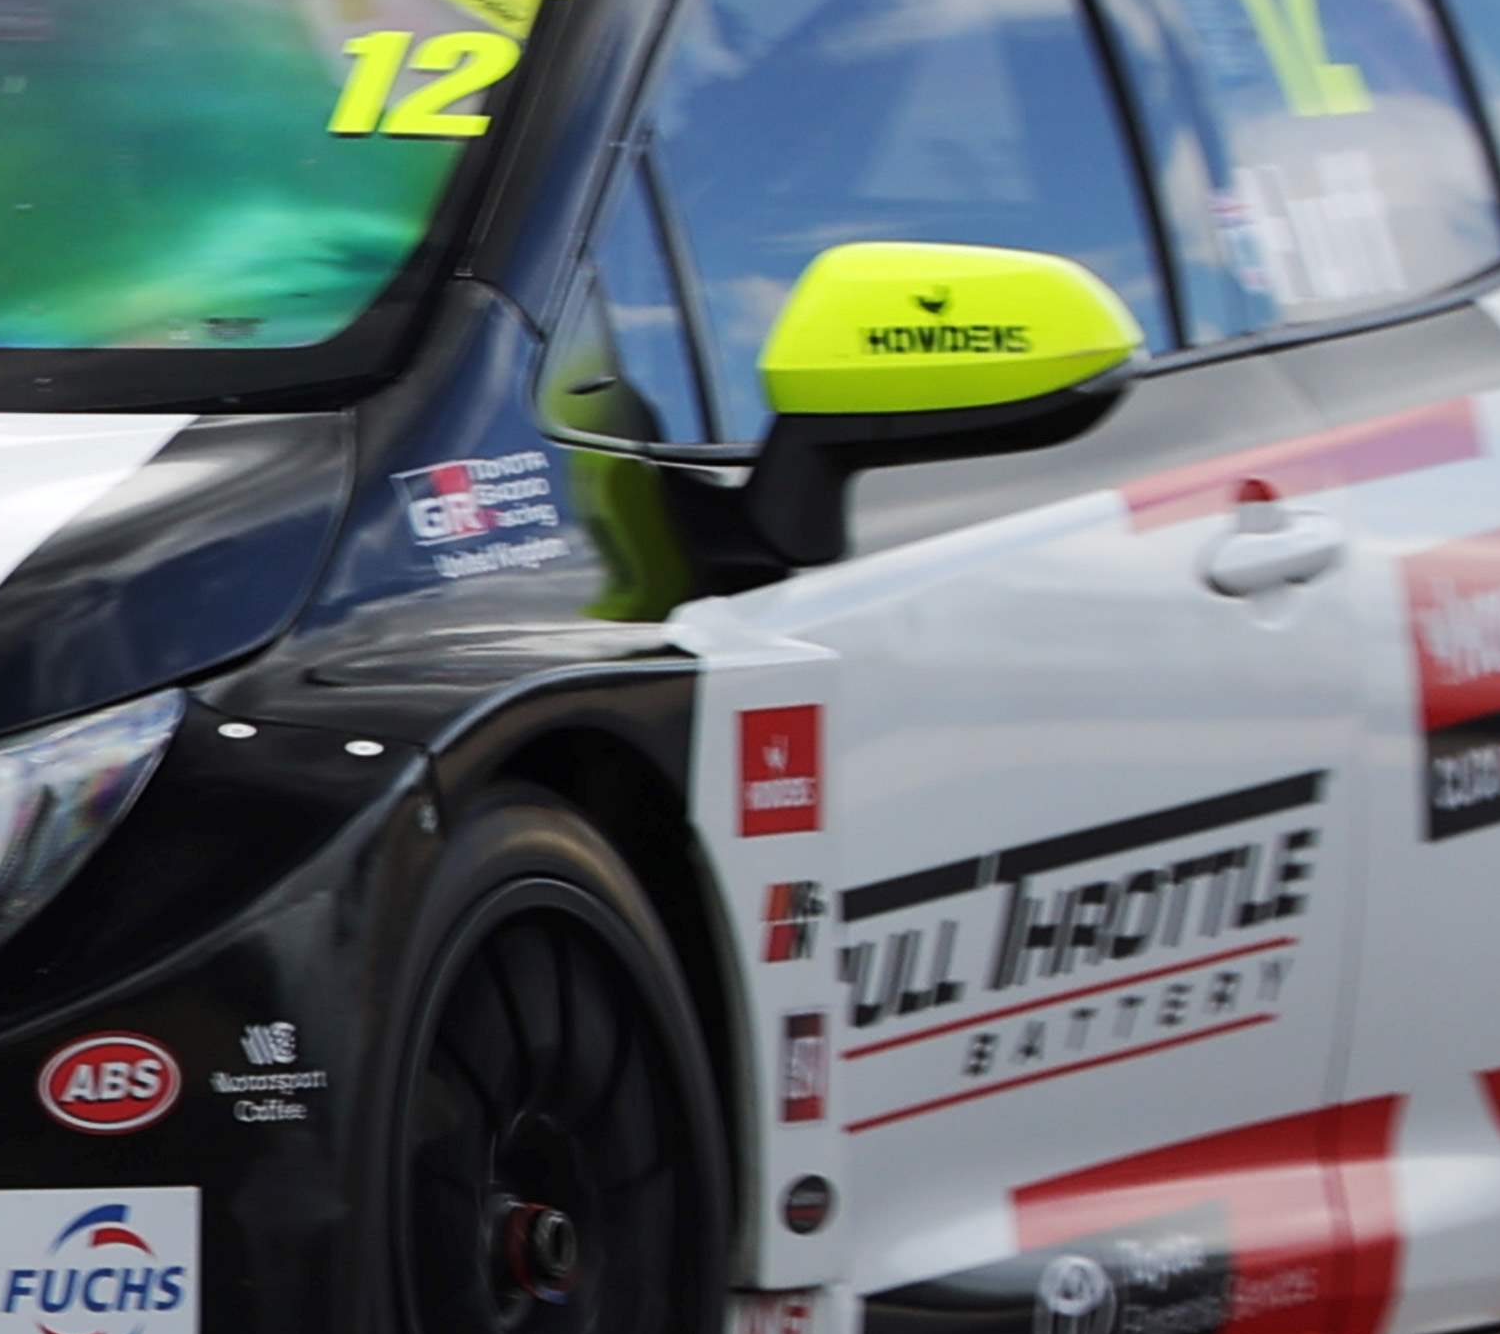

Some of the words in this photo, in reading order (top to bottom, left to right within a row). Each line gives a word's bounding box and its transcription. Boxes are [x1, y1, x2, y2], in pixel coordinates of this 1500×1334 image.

[327, 30, 521, 137] 12
[864, 325, 1033, 354] HOWDENS
[985, 828, 1319, 991] THROTTLE
[963, 957, 1293, 1076] BATTERY
[60, 1059, 163, 1104] ABS
[1, 1265, 185, 1313] FUCHS
